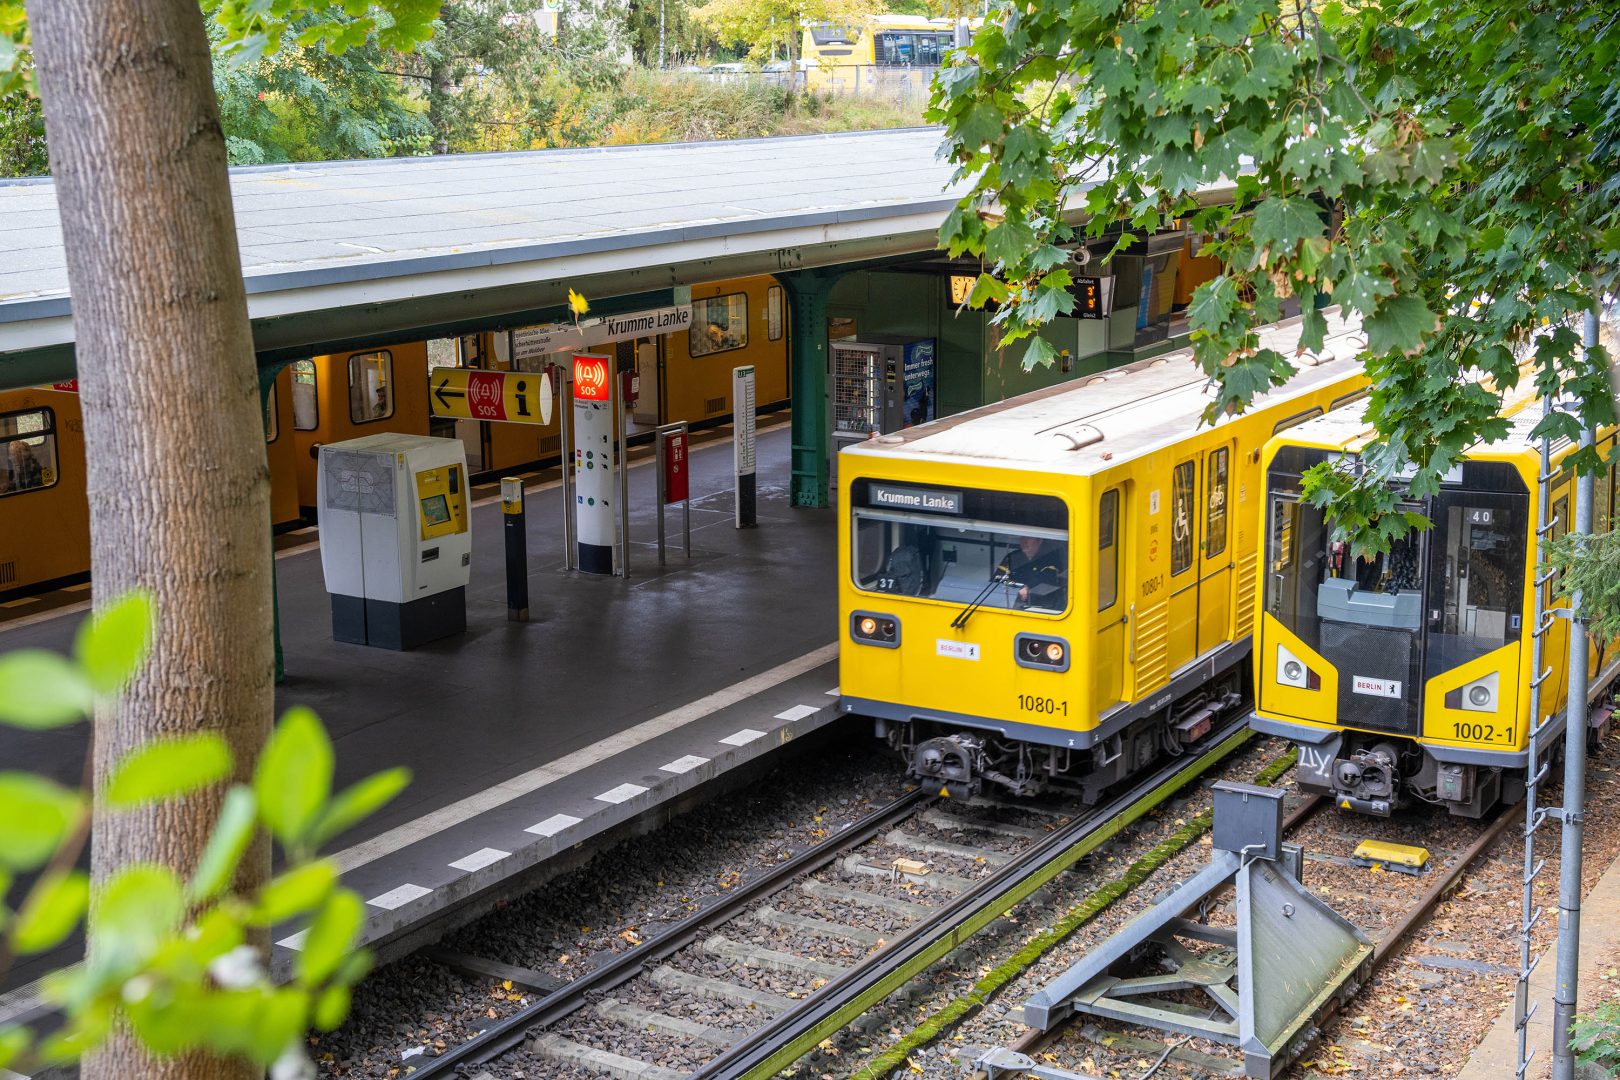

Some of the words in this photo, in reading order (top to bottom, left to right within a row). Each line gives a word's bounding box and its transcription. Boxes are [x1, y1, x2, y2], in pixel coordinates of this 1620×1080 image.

[608, 317, 653, 336] Krumme
[657, 308, 689, 328] Lanke
[905, 362, 921, 371] Immer
[921, 357, 933, 367] fresh
[580, 386, 596, 396] SOS
[478, 405, 497, 416] SOS
[877, 490, 920, 505] Krumme
[922, 495, 954, 509] Lanke
[1141, 573, 1164, 597] 1080-1
[940, 644, 962, 653] BERLIN
[1357, 681, 1381, 691] BERLIN
[1018, 694, 1068, 717] 1080-1
[1453, 722, 1513, 743] 1002-1
